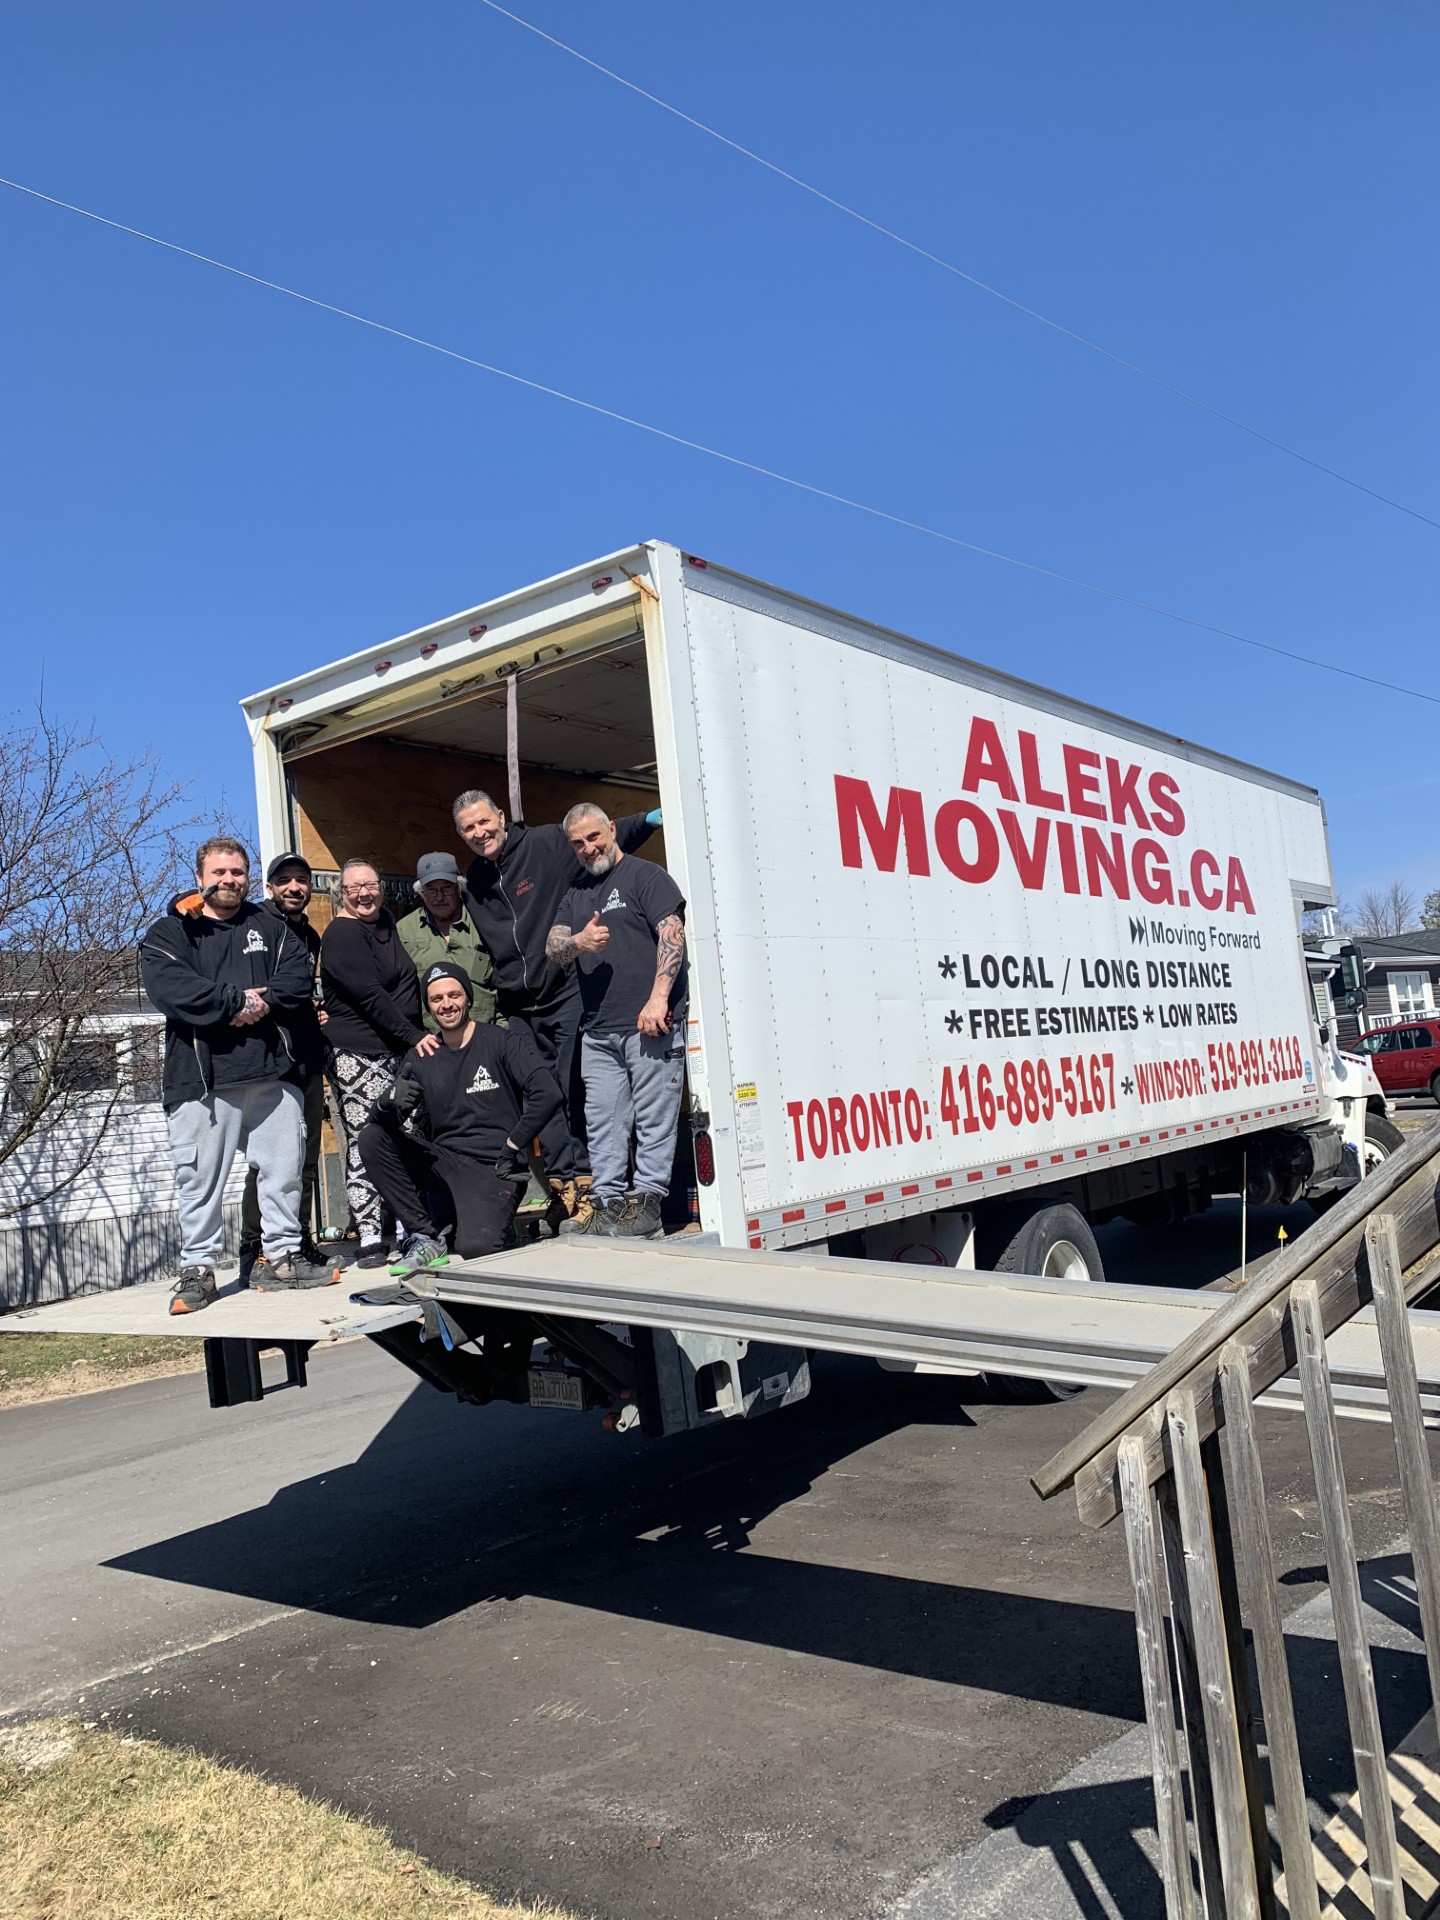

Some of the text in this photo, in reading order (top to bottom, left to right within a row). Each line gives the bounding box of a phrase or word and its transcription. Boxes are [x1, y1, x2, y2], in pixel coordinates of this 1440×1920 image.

[962, 716, 1186, 836] ALEKS
[833, 774, 1256, 915] MOVING.CA
[1080, 958, 1141, 989] LONG
[1146, 961, 1232, 988] DISTANCE
[1150, 920, 1261, 952] Moving Forward
[1035, 1005, 1139, 1036] ESTIMATES
[1196, 1002, 1238, 1026] RATES
[787, 1087, 933, 1162] TORONTO:
[940, 1053, 1117, 1136] 416-889-5167
[1207, 1035, 1303, 1093] 519-991-3118
